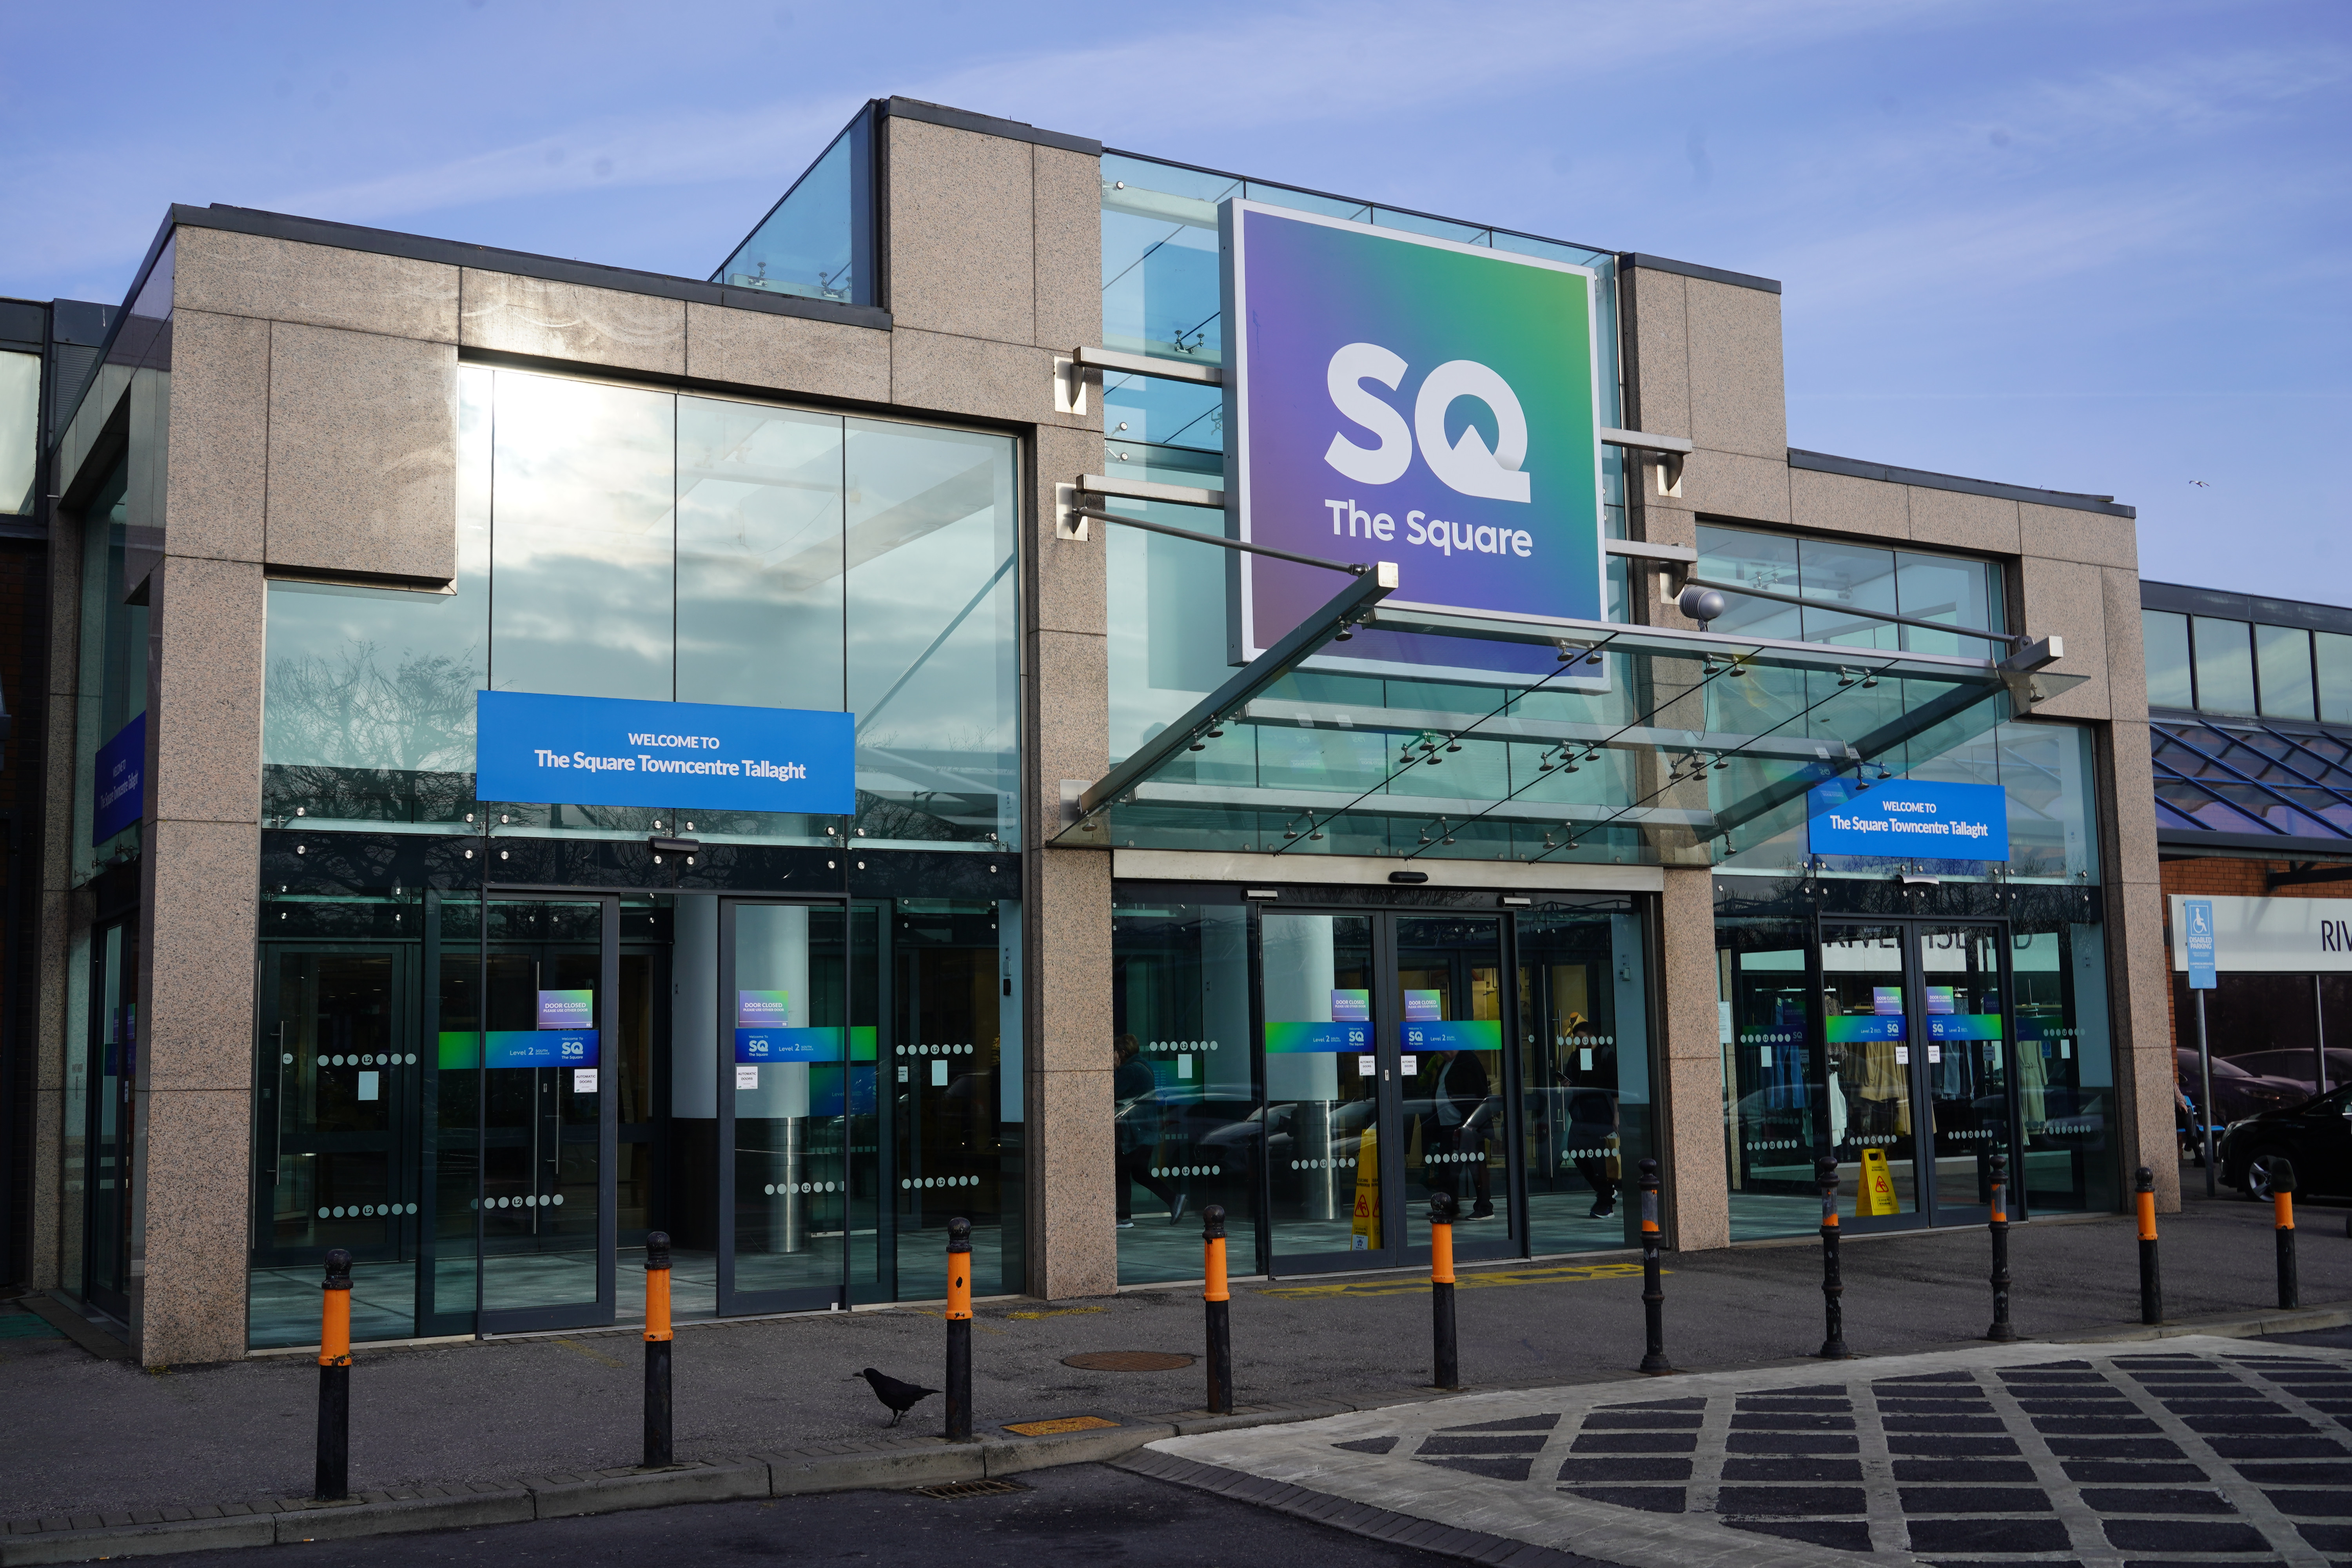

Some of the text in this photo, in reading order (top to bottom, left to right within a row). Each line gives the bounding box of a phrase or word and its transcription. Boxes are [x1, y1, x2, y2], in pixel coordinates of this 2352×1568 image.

[1324, 343, 1531, 503] SQ
[1325, 499, 1532, 557] The Square
[628, 733, 720, 749] WELCOME TO
[534, 749, 806, 782] The Square Towncentre Tallaght
[1883, 800, 1936, 813] WELCOME TO
[1830, 815, 1988, 838] The Square Towncentre Tallaght
[1887, 1024, 1899, 1033] SQ
[1933, 1024, 1944, 1033] SQ
[1349, 1031, 1364, 1042] SQ
[1408, 1031, 1423, 1042] SQ
[528, 1047, 534, 1055] 2
[561, 1042, 583, 1054] SQ
[749, 1040, 768, 1052] SQ
